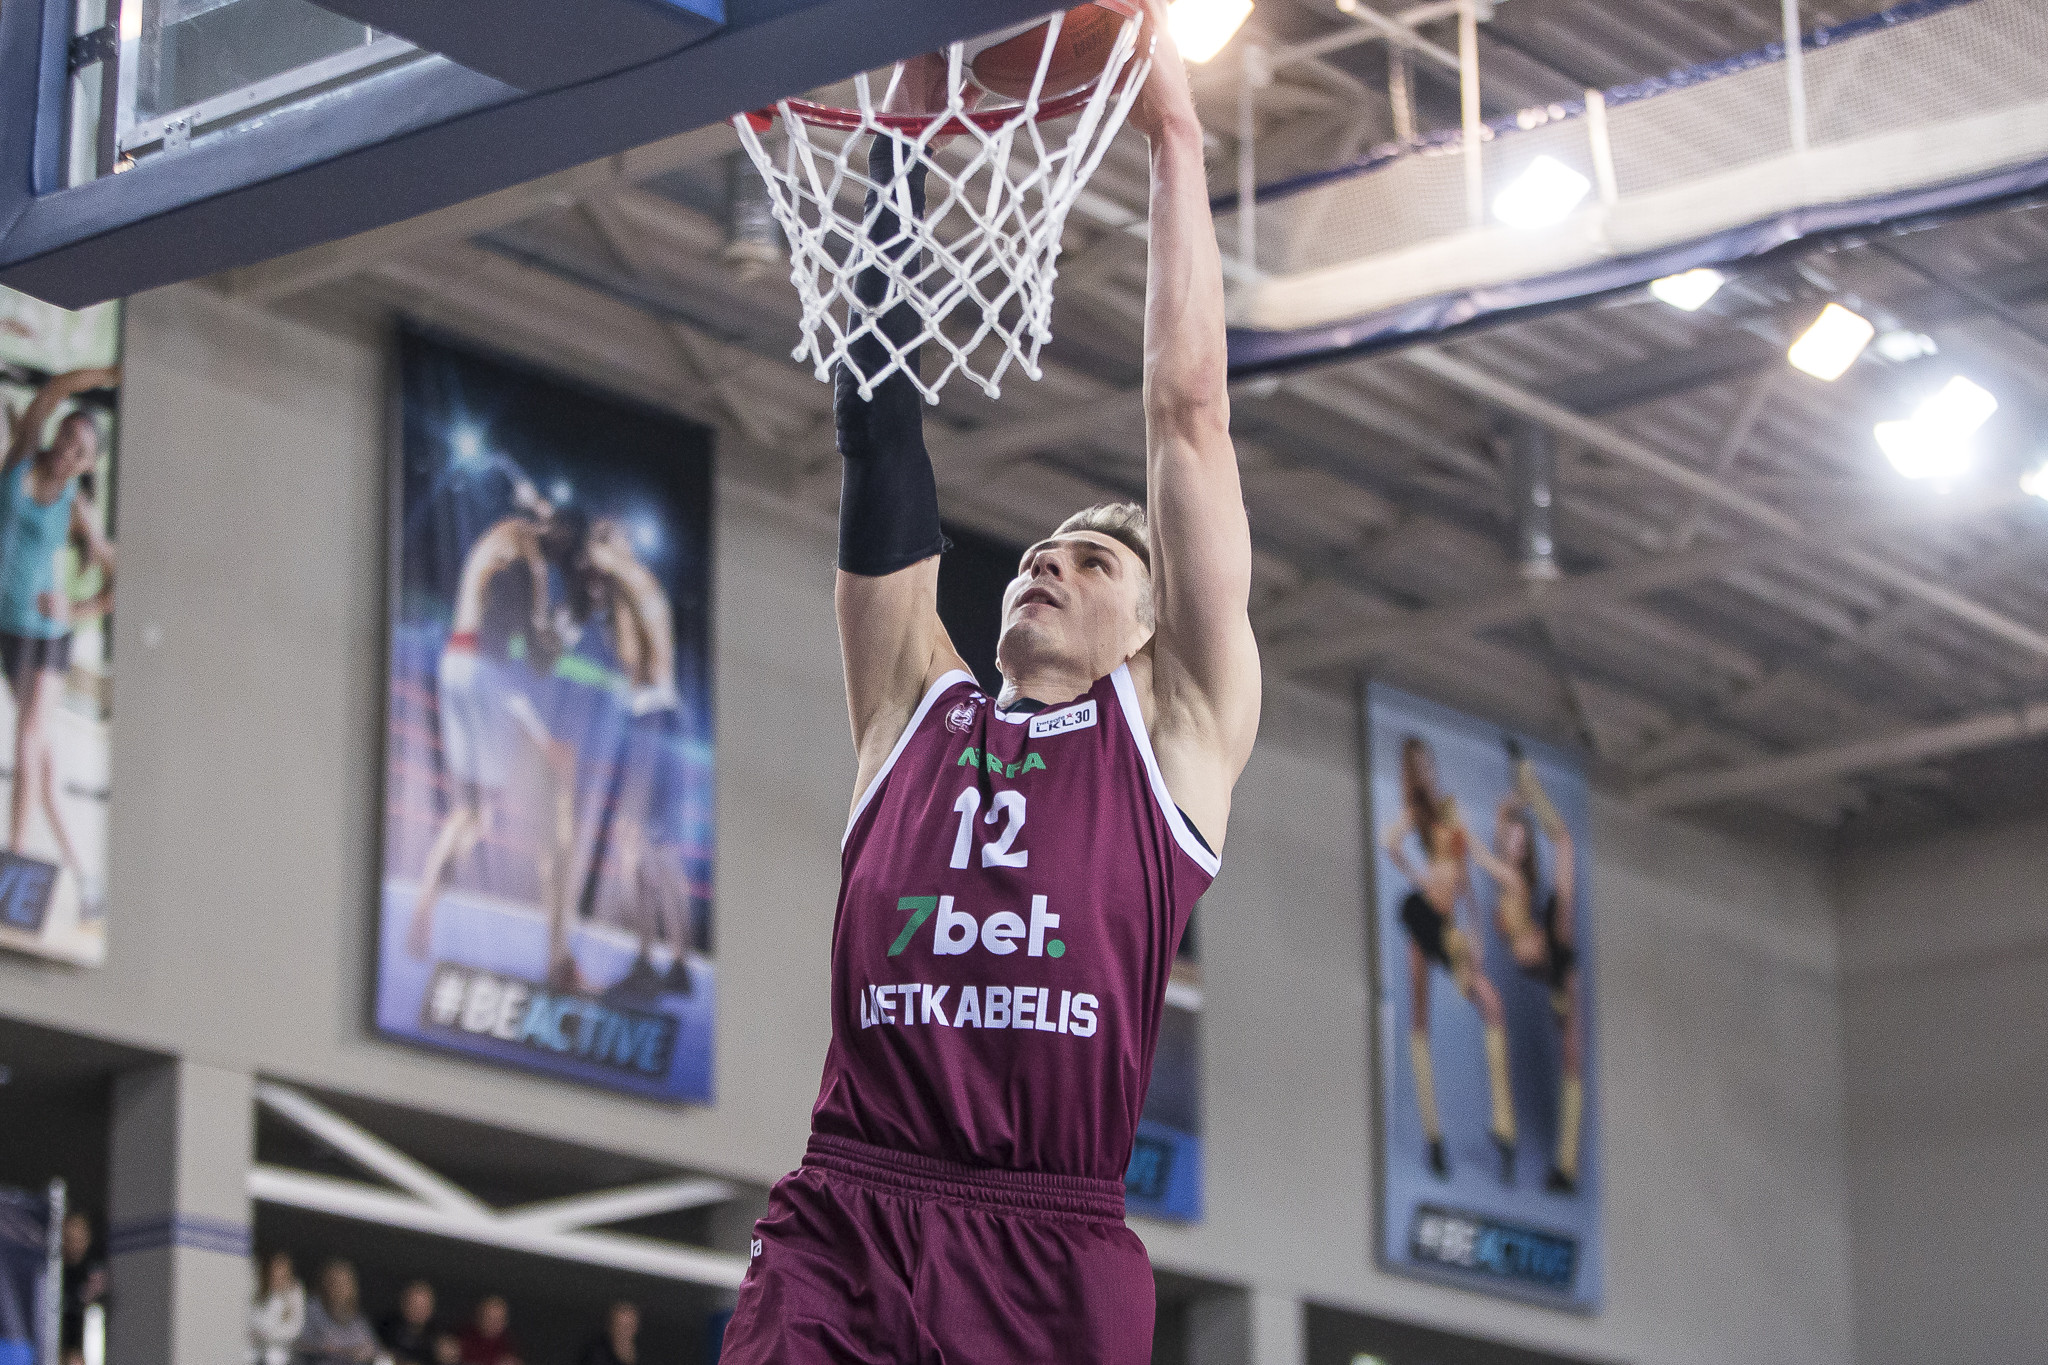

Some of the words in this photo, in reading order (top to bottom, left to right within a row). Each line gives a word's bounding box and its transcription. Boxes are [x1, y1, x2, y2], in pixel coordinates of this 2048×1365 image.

[1075, 708, 1091, 724] 30
[957, 746, 1047, 779] NRFA
[949, 786, 1029, 869] 12
[860, 983, 1099, 1038] LIETKABELIS
